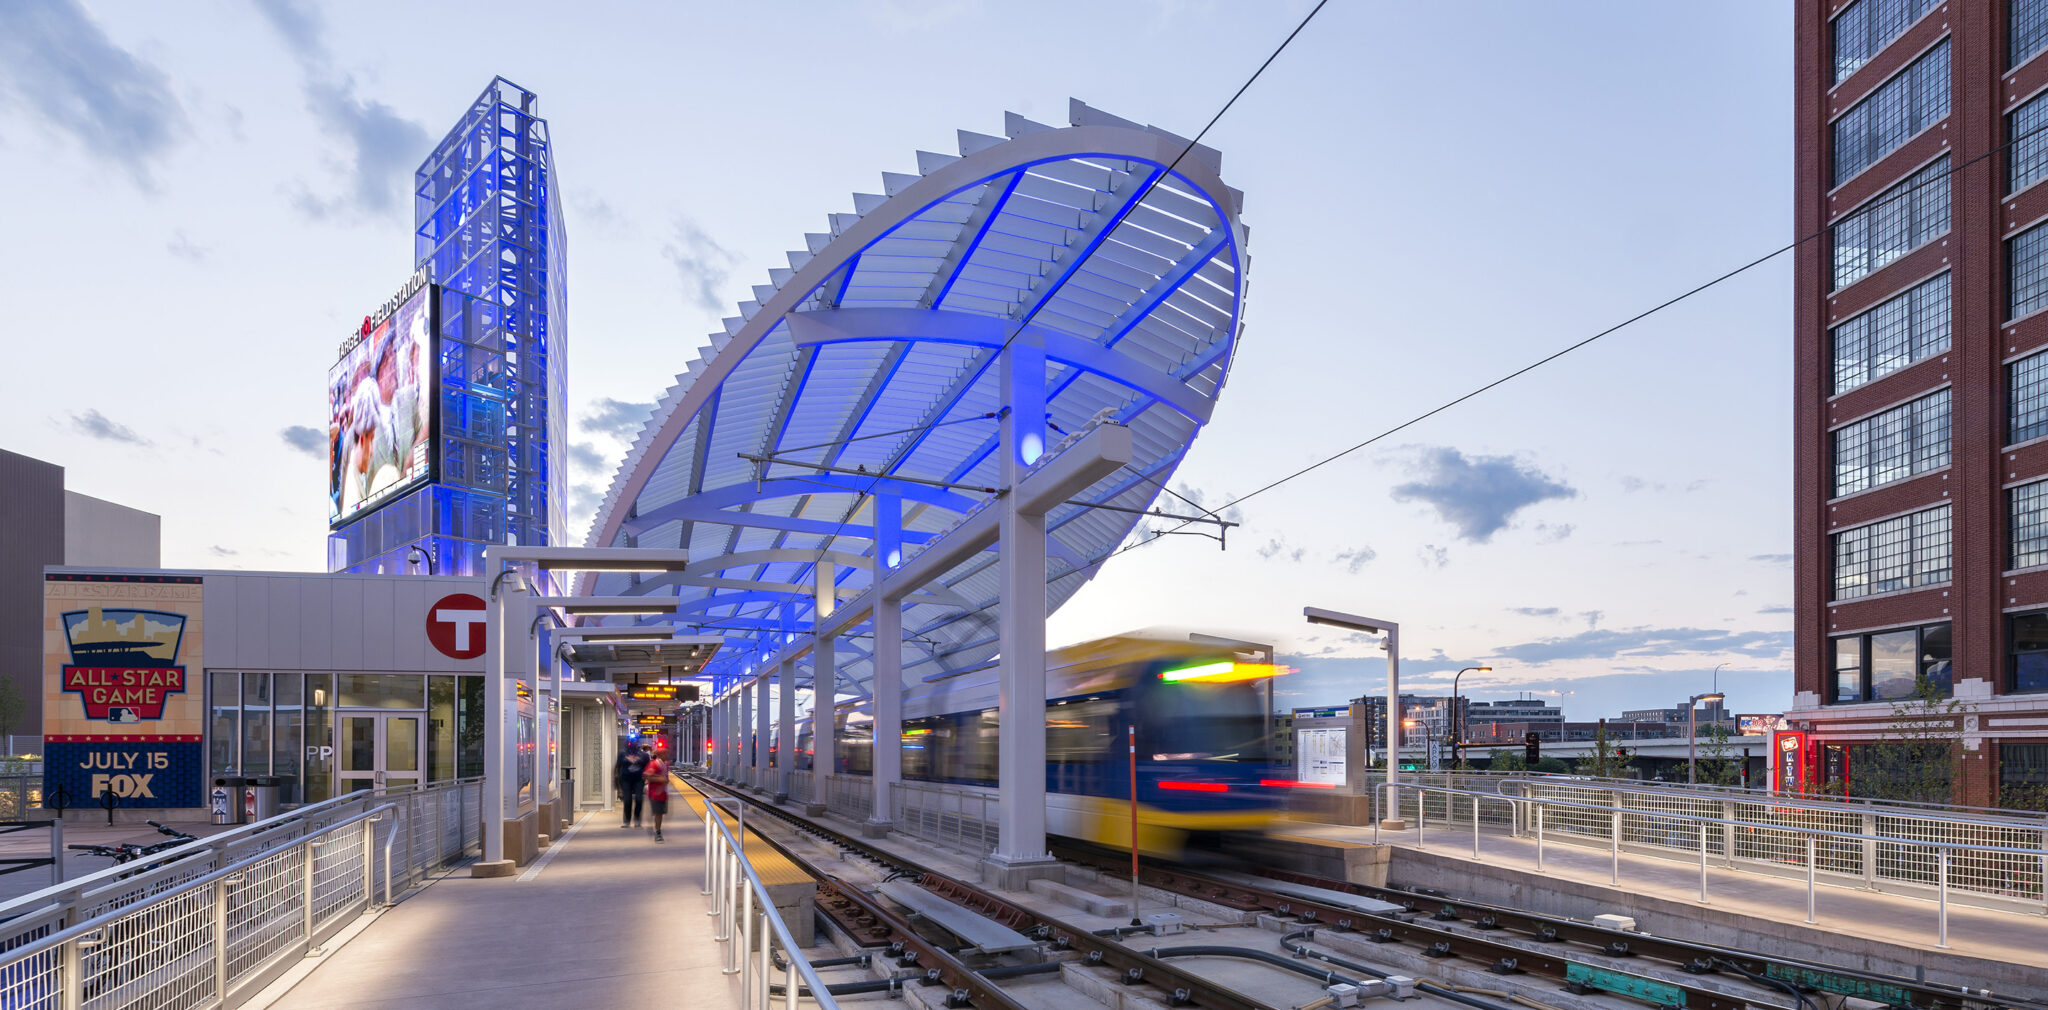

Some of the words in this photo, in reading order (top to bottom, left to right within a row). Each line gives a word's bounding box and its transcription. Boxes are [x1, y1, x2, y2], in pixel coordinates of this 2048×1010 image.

[337, 324, 363, 359] TARGET
[370, 301, 392, 332] FIELD
[393, 264, 427, 310] STATION
[436, 609, 486, 651] T
[70, 670, 112, 685] ALL
[122, 670, 180, 686] STAR
[92, 688, 157, 704] GAME
[80, 752, 139, 769] JULY
[147, 752, 169, 769] 15
[91, 773, 155, 798] FOX
